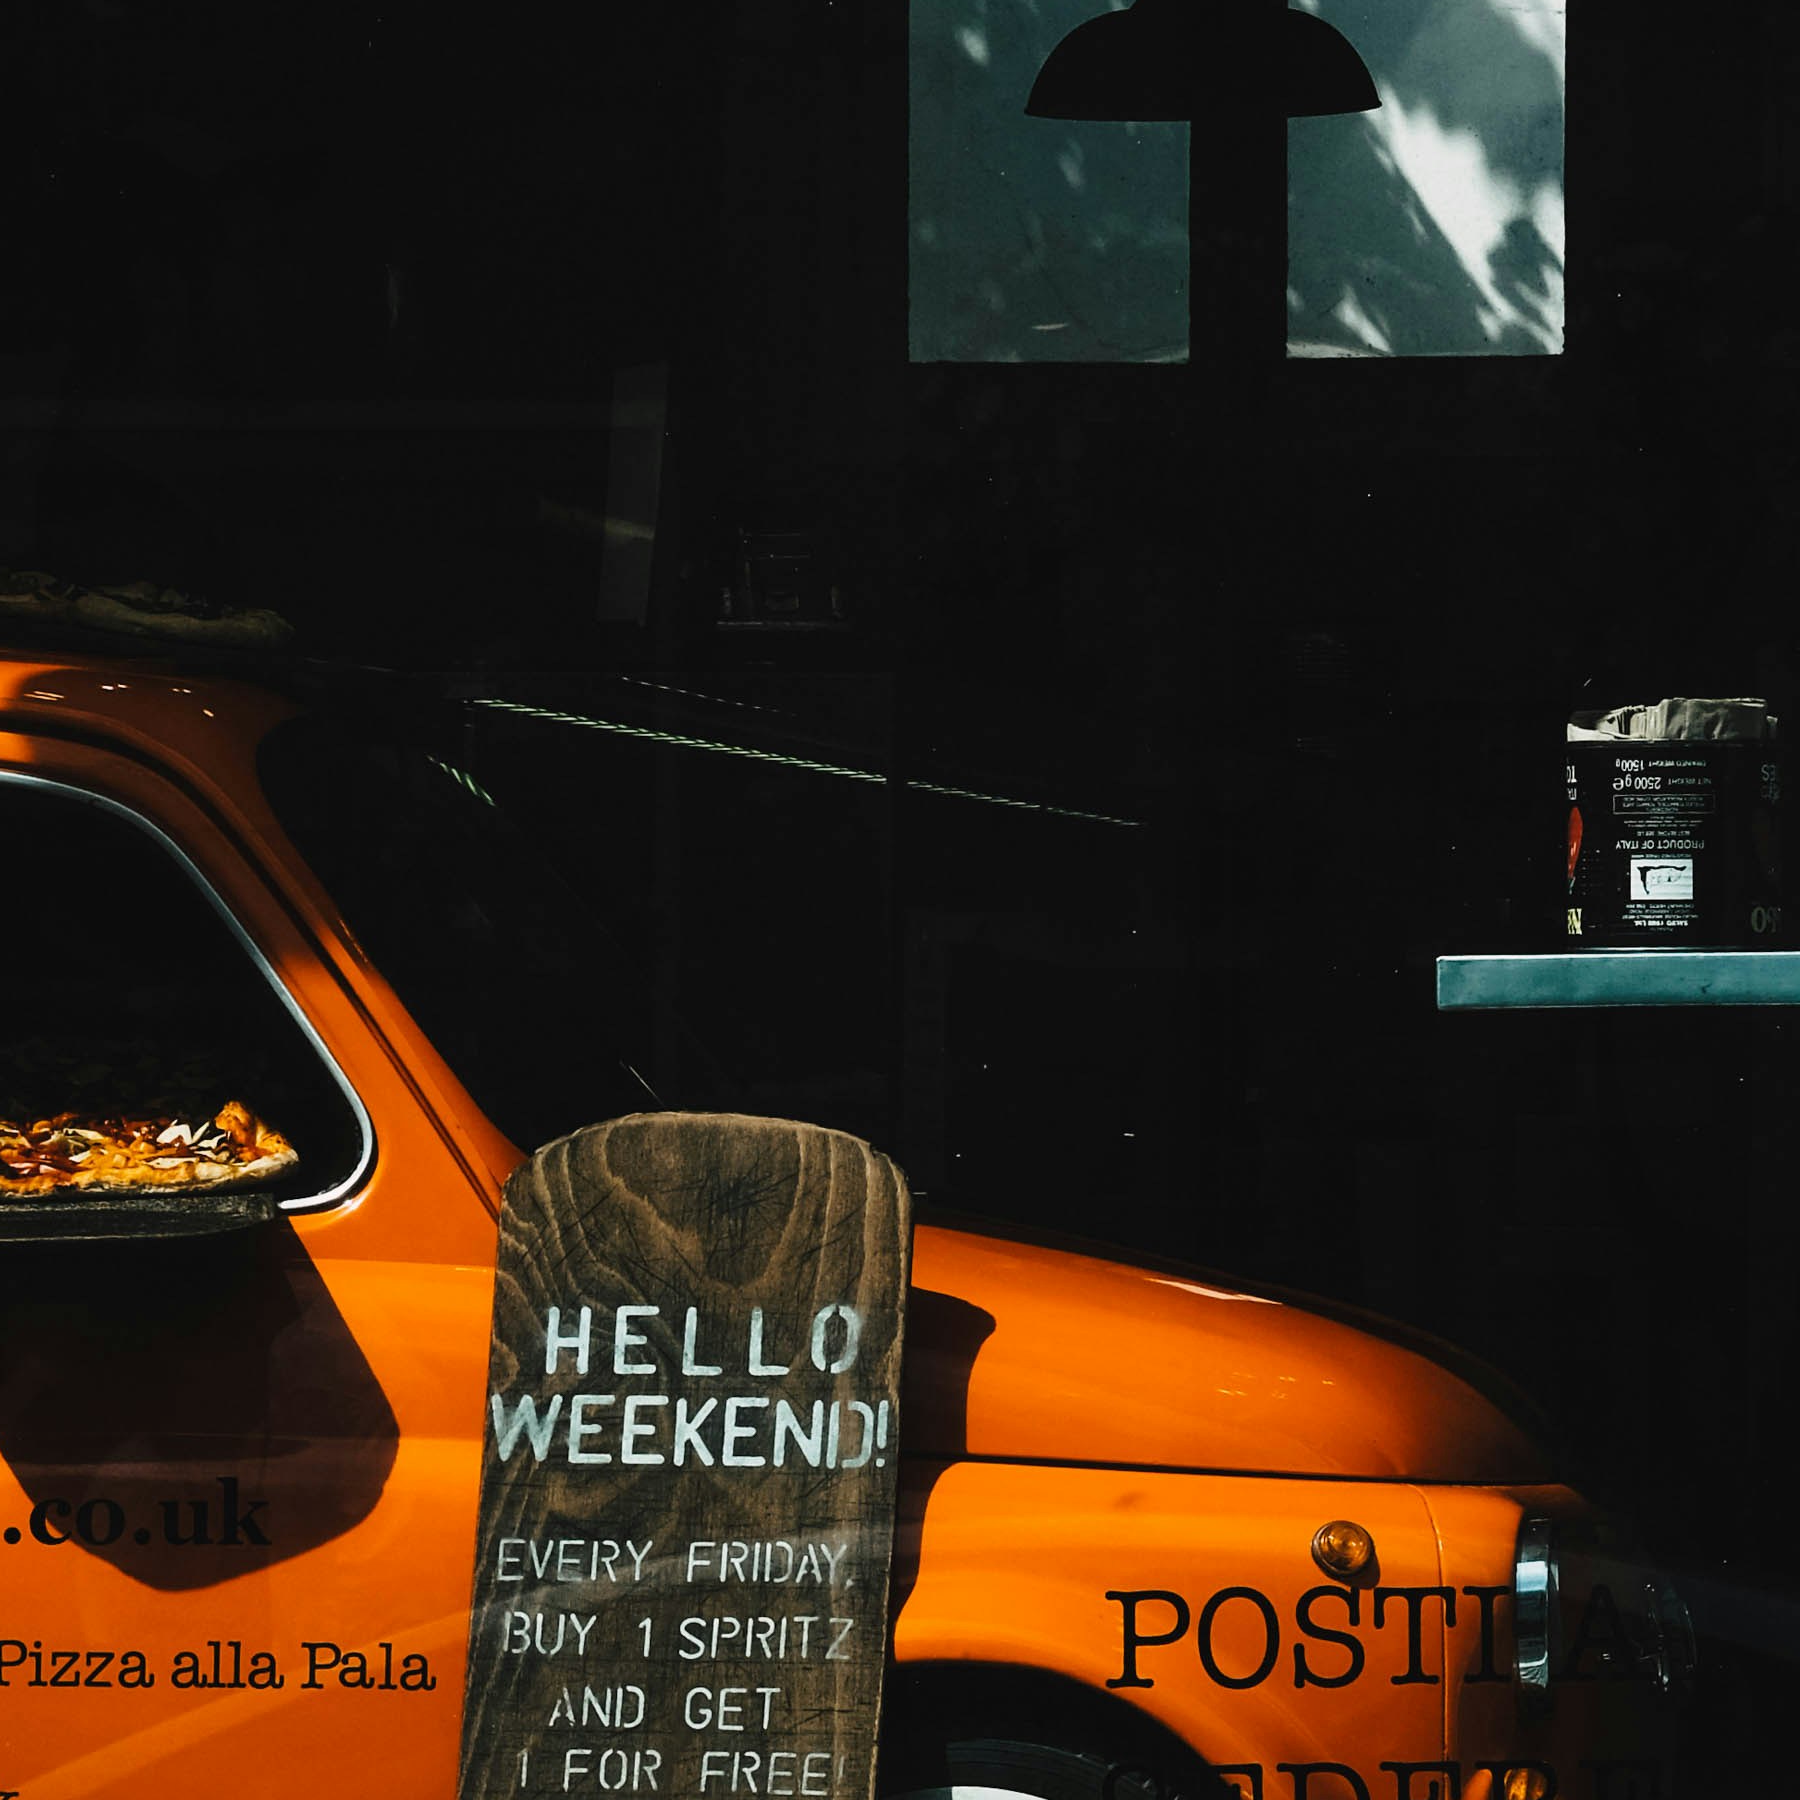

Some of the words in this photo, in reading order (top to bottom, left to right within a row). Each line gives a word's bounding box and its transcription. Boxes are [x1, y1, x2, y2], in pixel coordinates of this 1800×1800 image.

[1615, 838, 1639, 850] ITALY
[1640, 838, 1655, 850] OF
[1656, 838, 1705, 850] PRODUCT
[545, 1303, 861, 1377] HELLO
[491, 1392, 889, 1470] WEEKEND!
[497, 1538, 654, 1582] EVERY
[502, 1610, 598, 1657] BUY
[637, 1616, 652, 1658] 1
[677, 1615, 855, 1661] SPRITZ
[1105, 1585, 1518, 1689] POSTI
[171, 1640, 285, 1690] alla
[301, 1642, 437, 1691] Pala
[548, 1684, 646, 1730] AND
[684, 1686, 781, 1732] GET
[515, 1748, 529, 1789] 1
[561, 1748, 663, 1793] FOR
